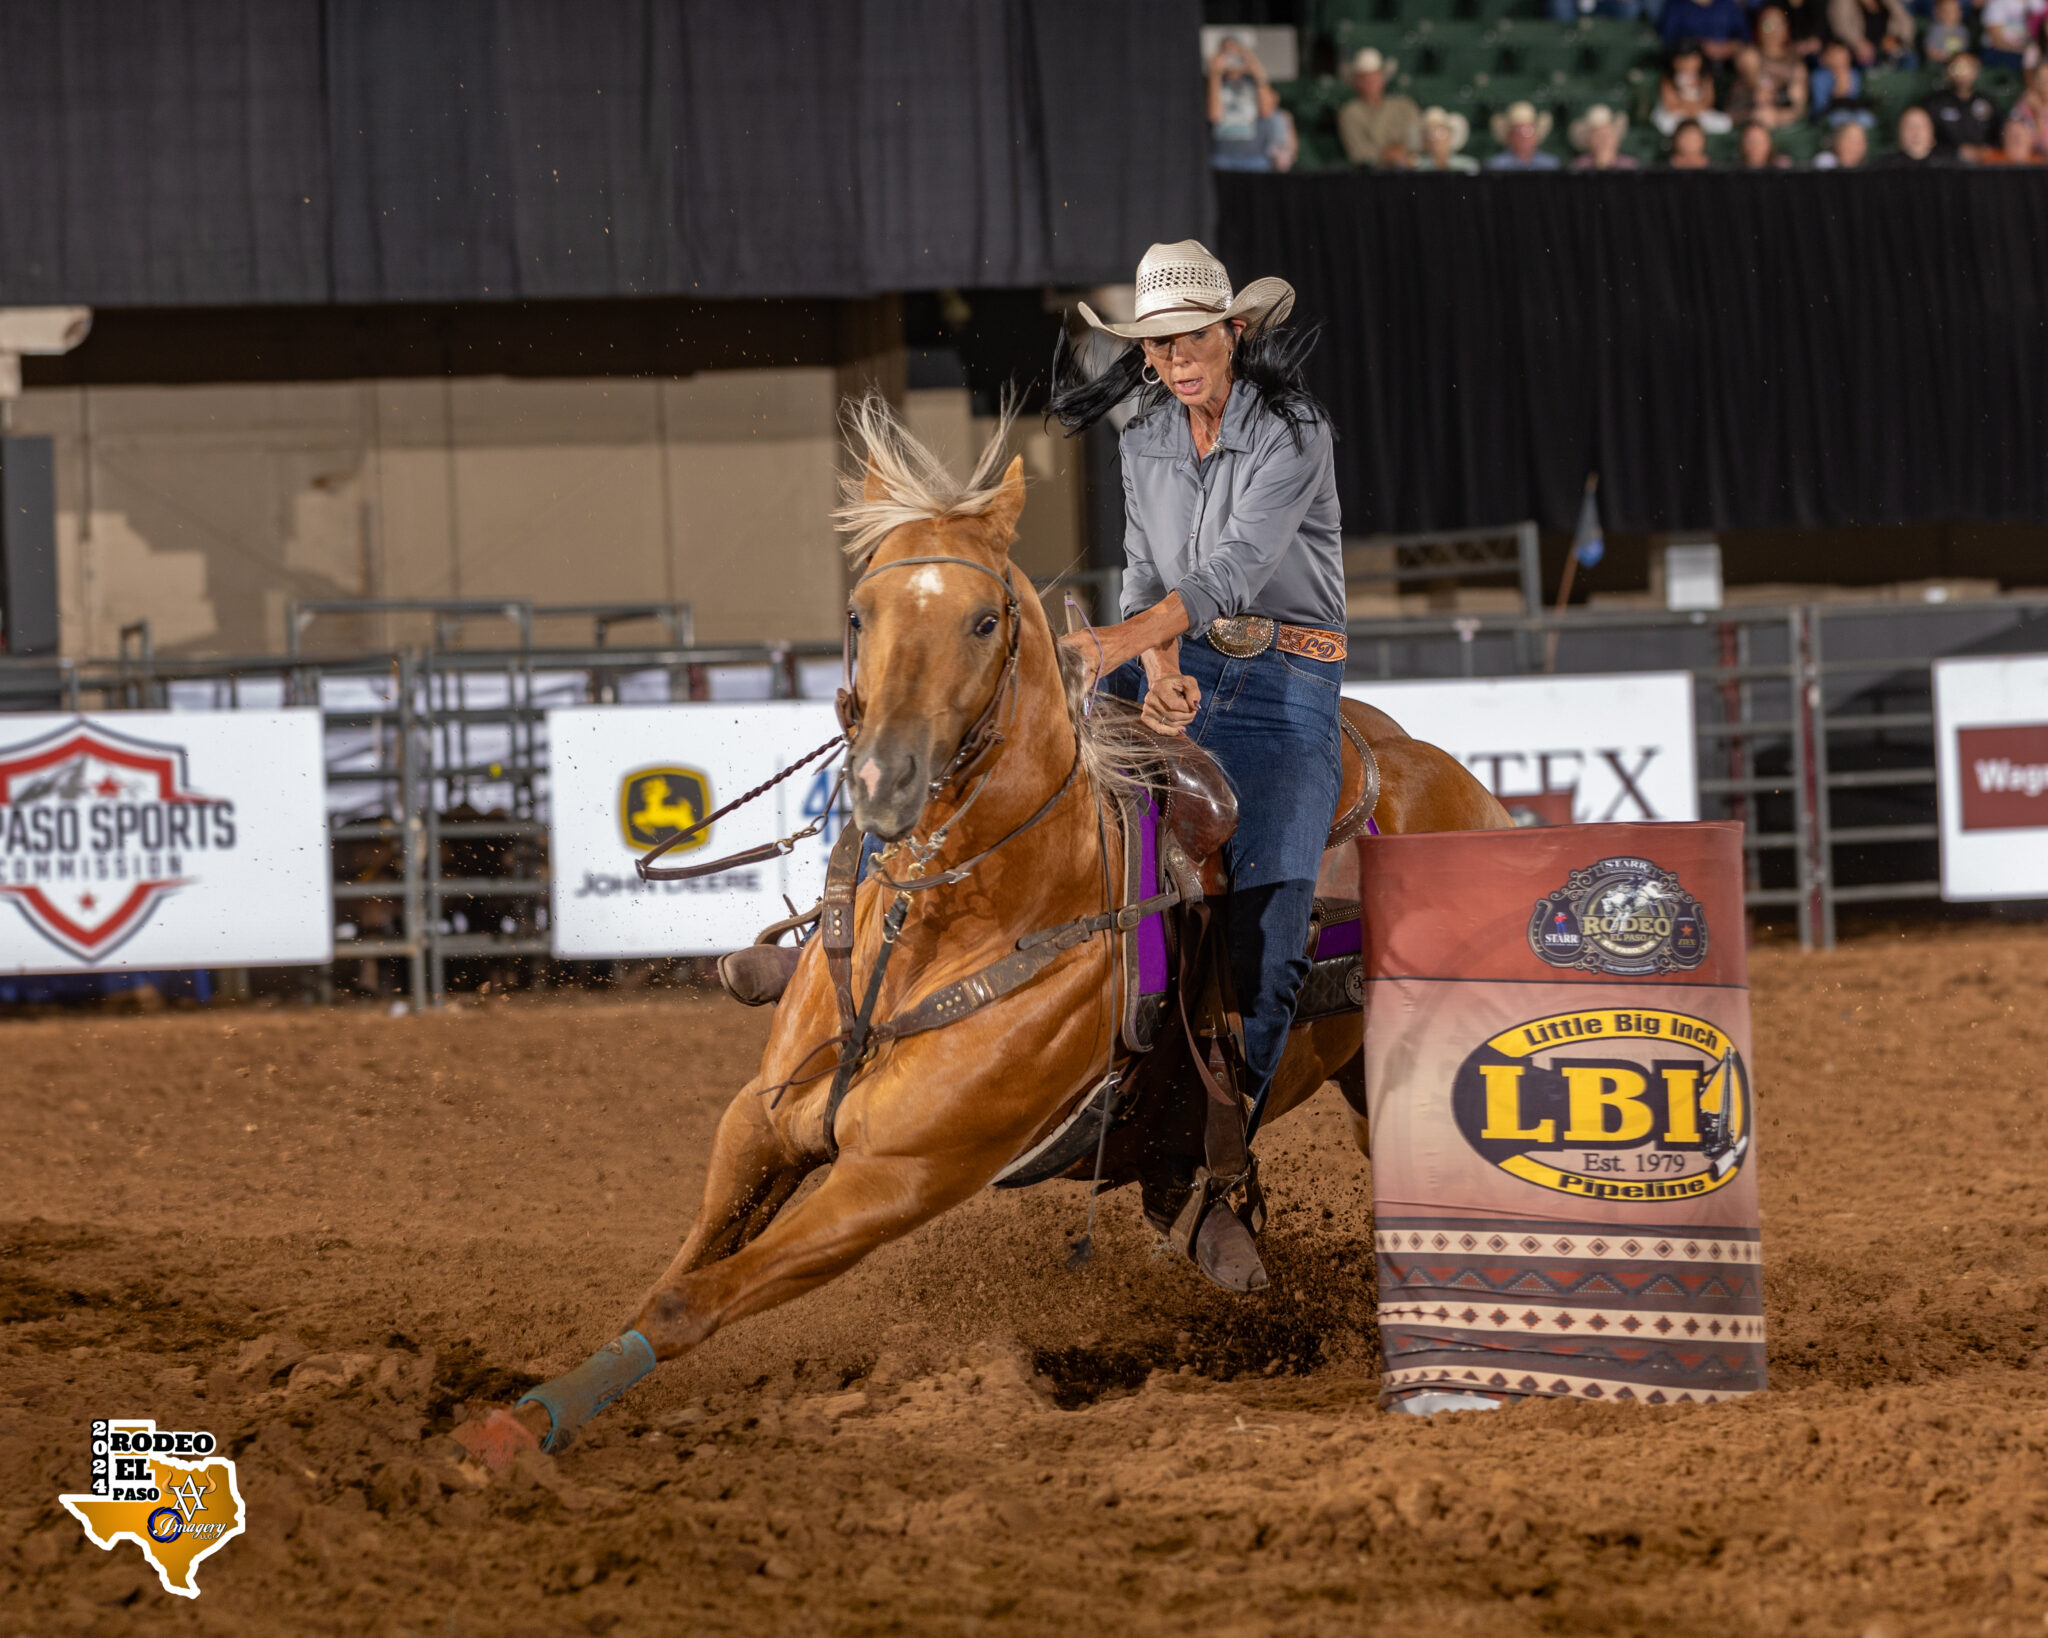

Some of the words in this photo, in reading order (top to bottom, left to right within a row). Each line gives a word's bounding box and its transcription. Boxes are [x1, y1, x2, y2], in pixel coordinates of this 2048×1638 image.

[1452, 745, 1662, 824] TEX
[1974, 757, 2048, 797] Wag
[0, 802, 79, 854] ASO
[90, 800, 236, 852] SPORTS
[1605, 860, 1649, 870] STARR
[1545, 932, 1581, 944] STARR
[1582, 915, 1671, 937] RODEO
[1610, 933, 1622, 941] EL
[1624, 933, 1647, 942] PASO
[1523, 1014, 1603, 1047] Little
[1614, 1013, 1661, 1035] Big
[1670, 1018, 1718, 1050] Inch
[1479, 1064, 1703, 1143] LBI
[1582, 1152, 1626, 1173] Est.
[1636, 1153, 1686, 1173] 1979
[1557, 1174, 1706, 1199] Pipeline
